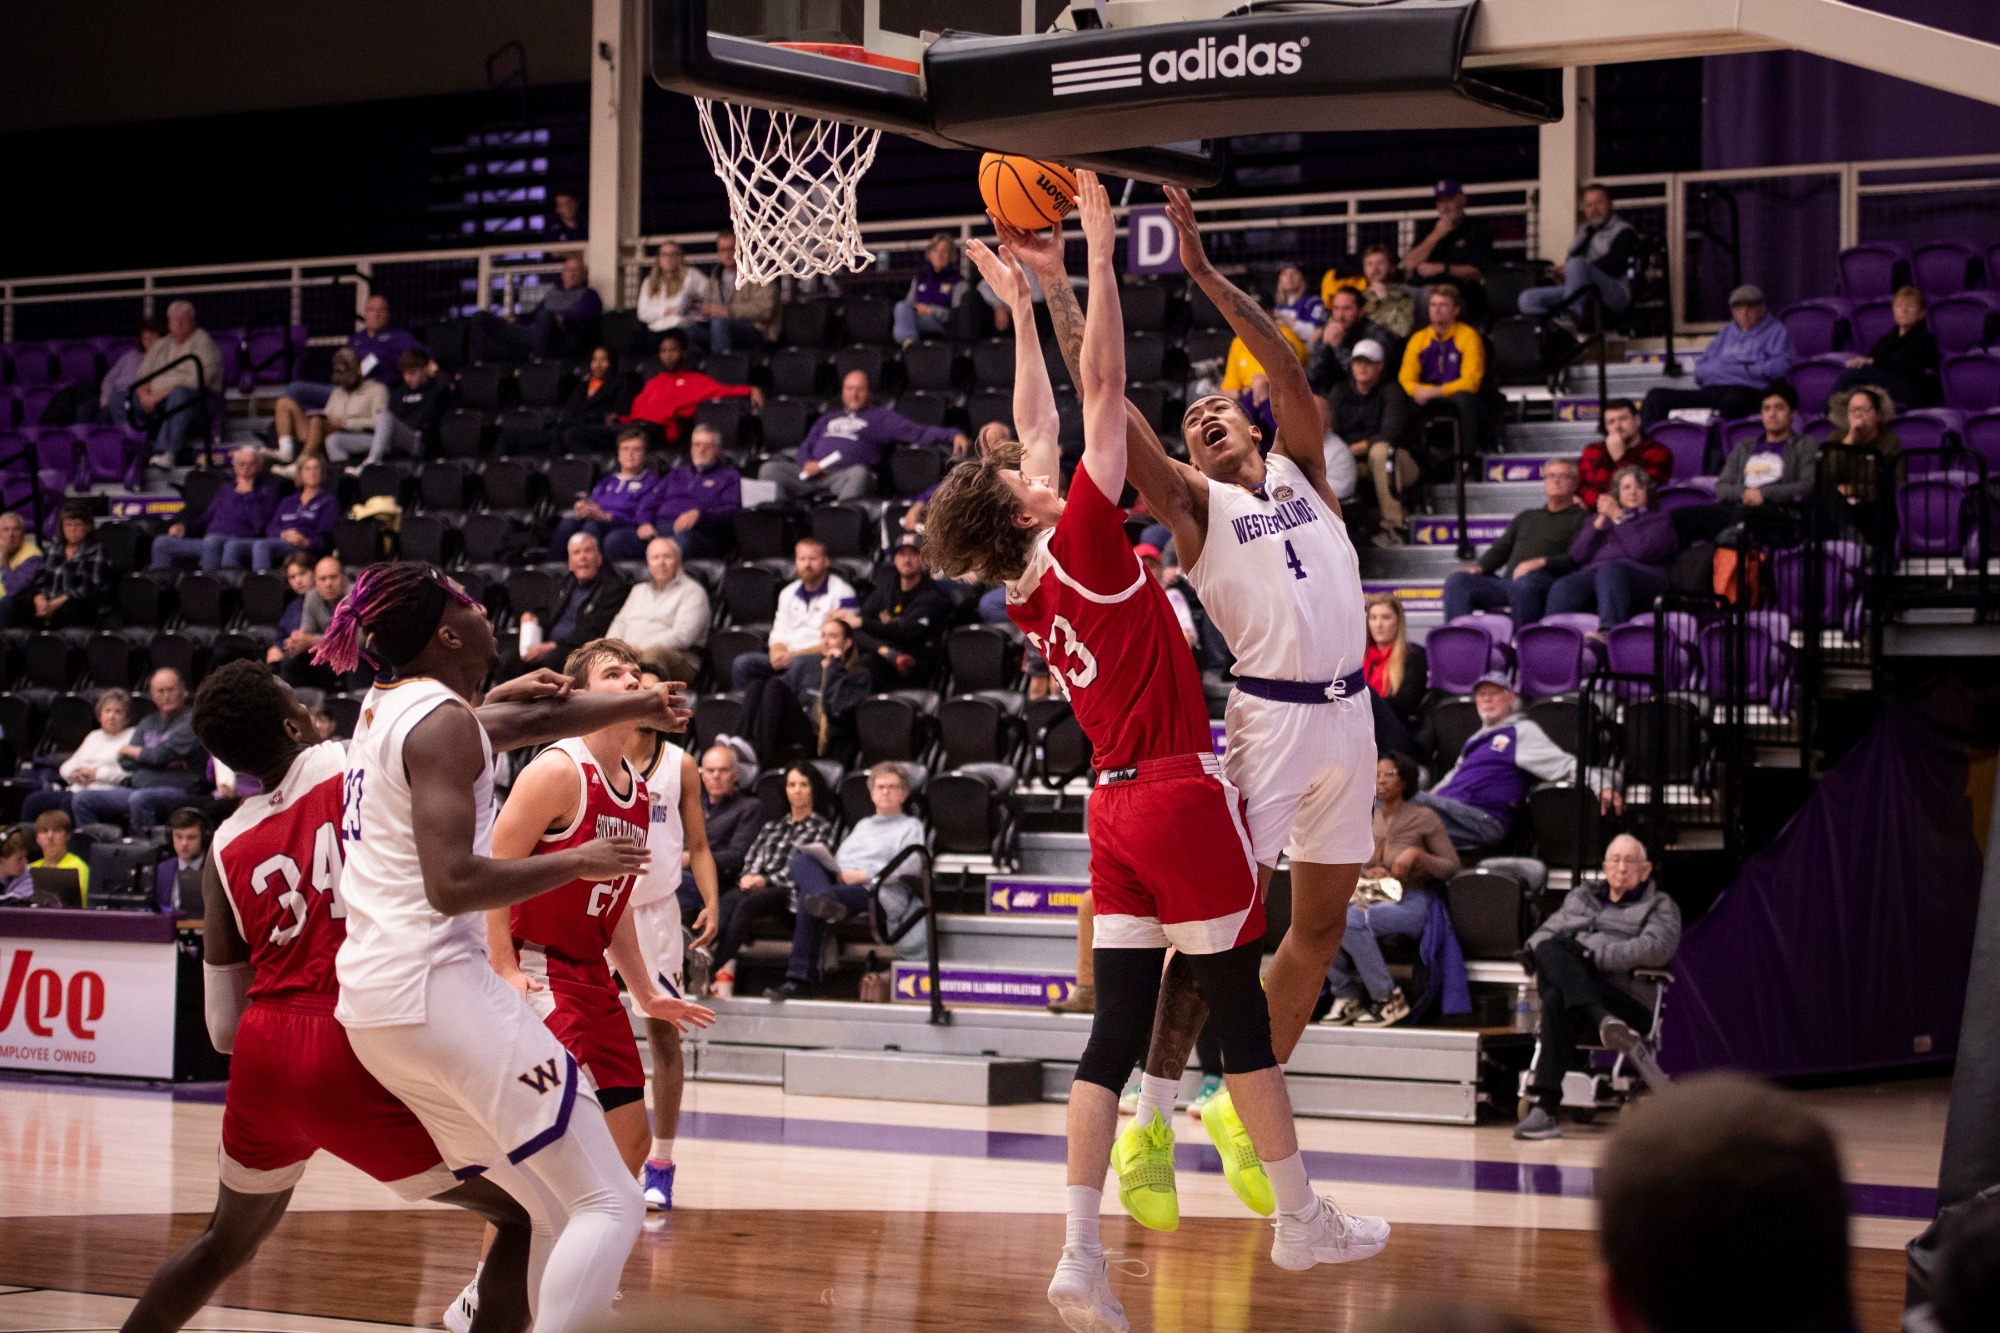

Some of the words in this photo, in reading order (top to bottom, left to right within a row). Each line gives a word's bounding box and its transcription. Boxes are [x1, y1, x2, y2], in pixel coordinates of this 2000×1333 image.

[1149, 34, 1302, 84] adidas
[1138, 215, 1175, 266] D
[1284, 540, 1307, 580] 4
[251, 821, 348, 946] 34
[53, 1048, 96, 1064] OWNED
[518, 1057, 561, 1095] W
